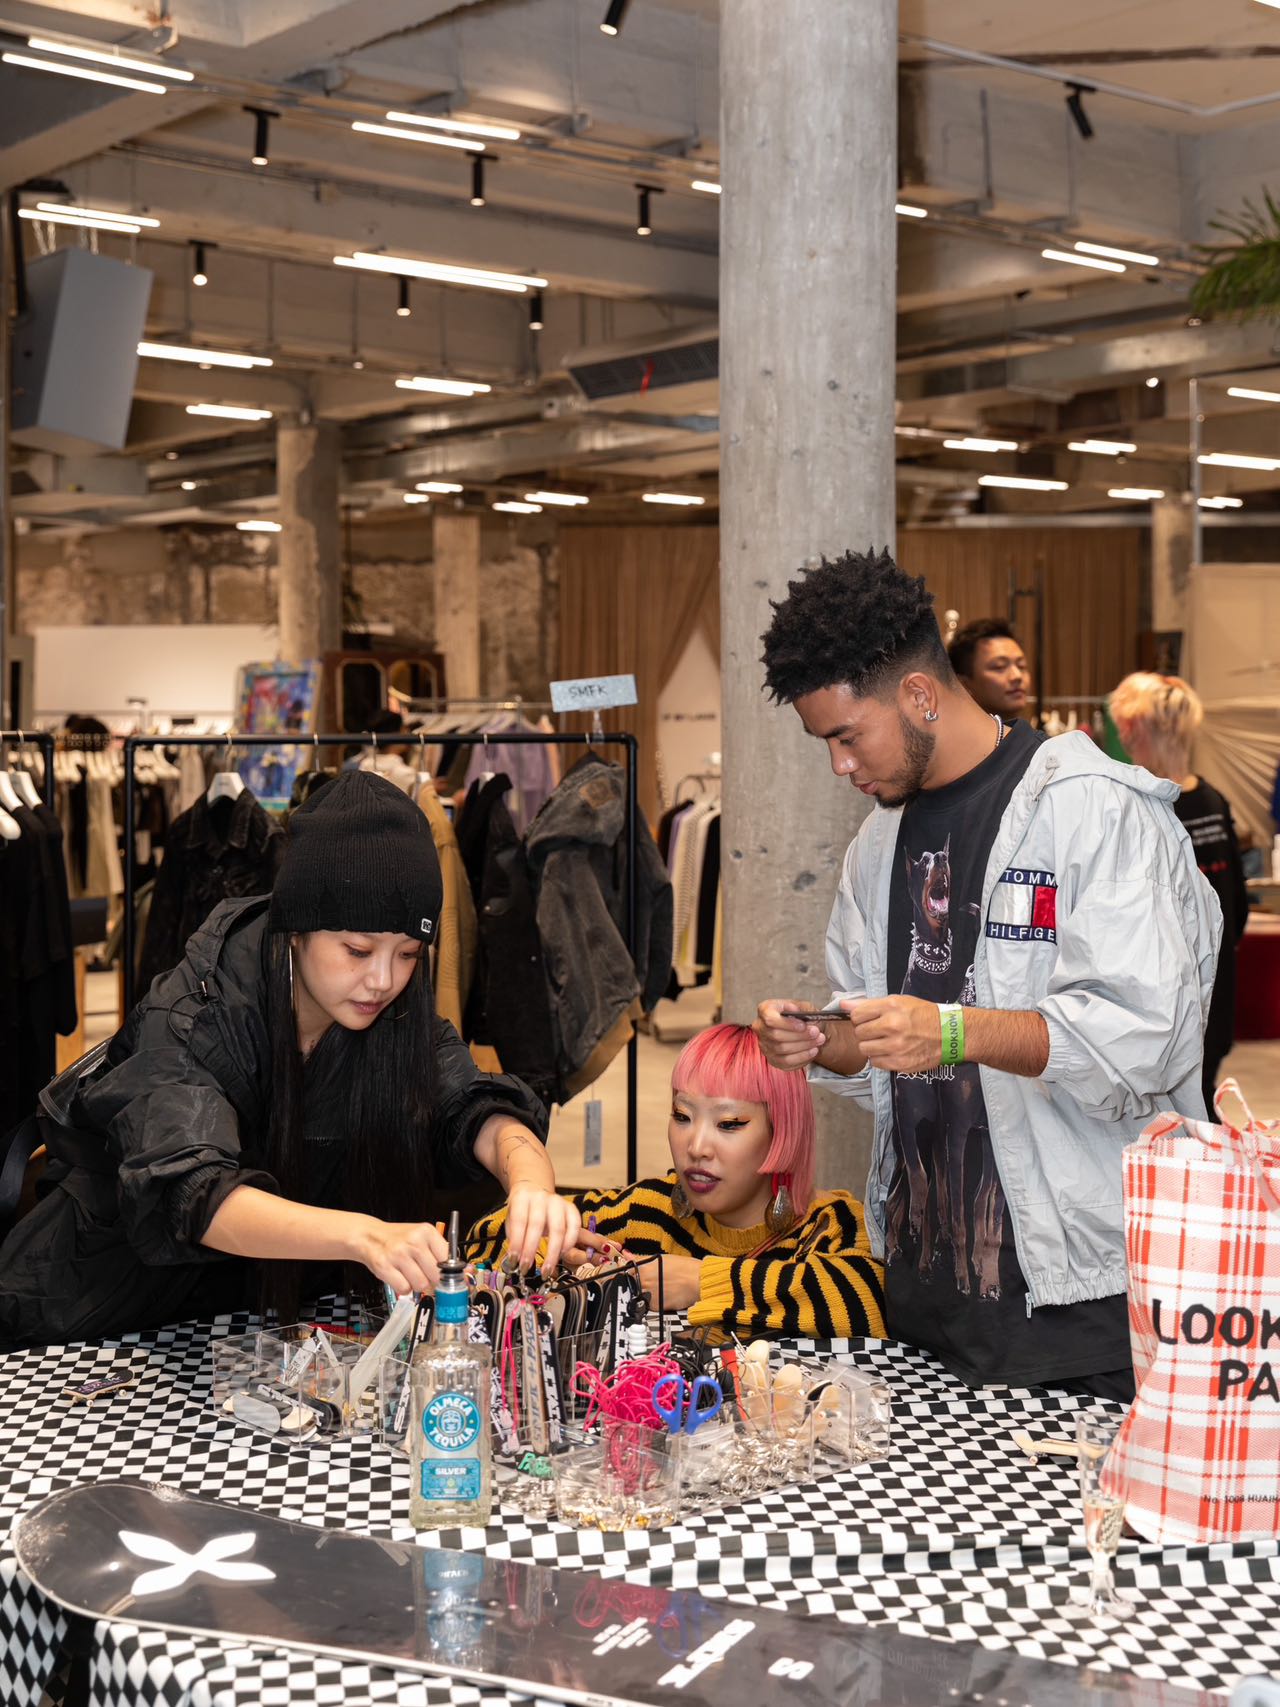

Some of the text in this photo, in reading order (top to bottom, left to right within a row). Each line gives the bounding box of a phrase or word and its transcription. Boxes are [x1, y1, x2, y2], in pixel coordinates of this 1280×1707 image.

[990, 924, 1056, 941] HILFIGE
[949, 1013, 959, 1060] LOOKNOW
[1152, 1298, 1280, 1349] LOOK
[1218, 1359, 1280, 1403] PA
[430, 1397, 473, 1416] OLMECA
[429, 1427, 475, 1448] TEQUILA
[435, 1467, 466, 1475] SILVER
